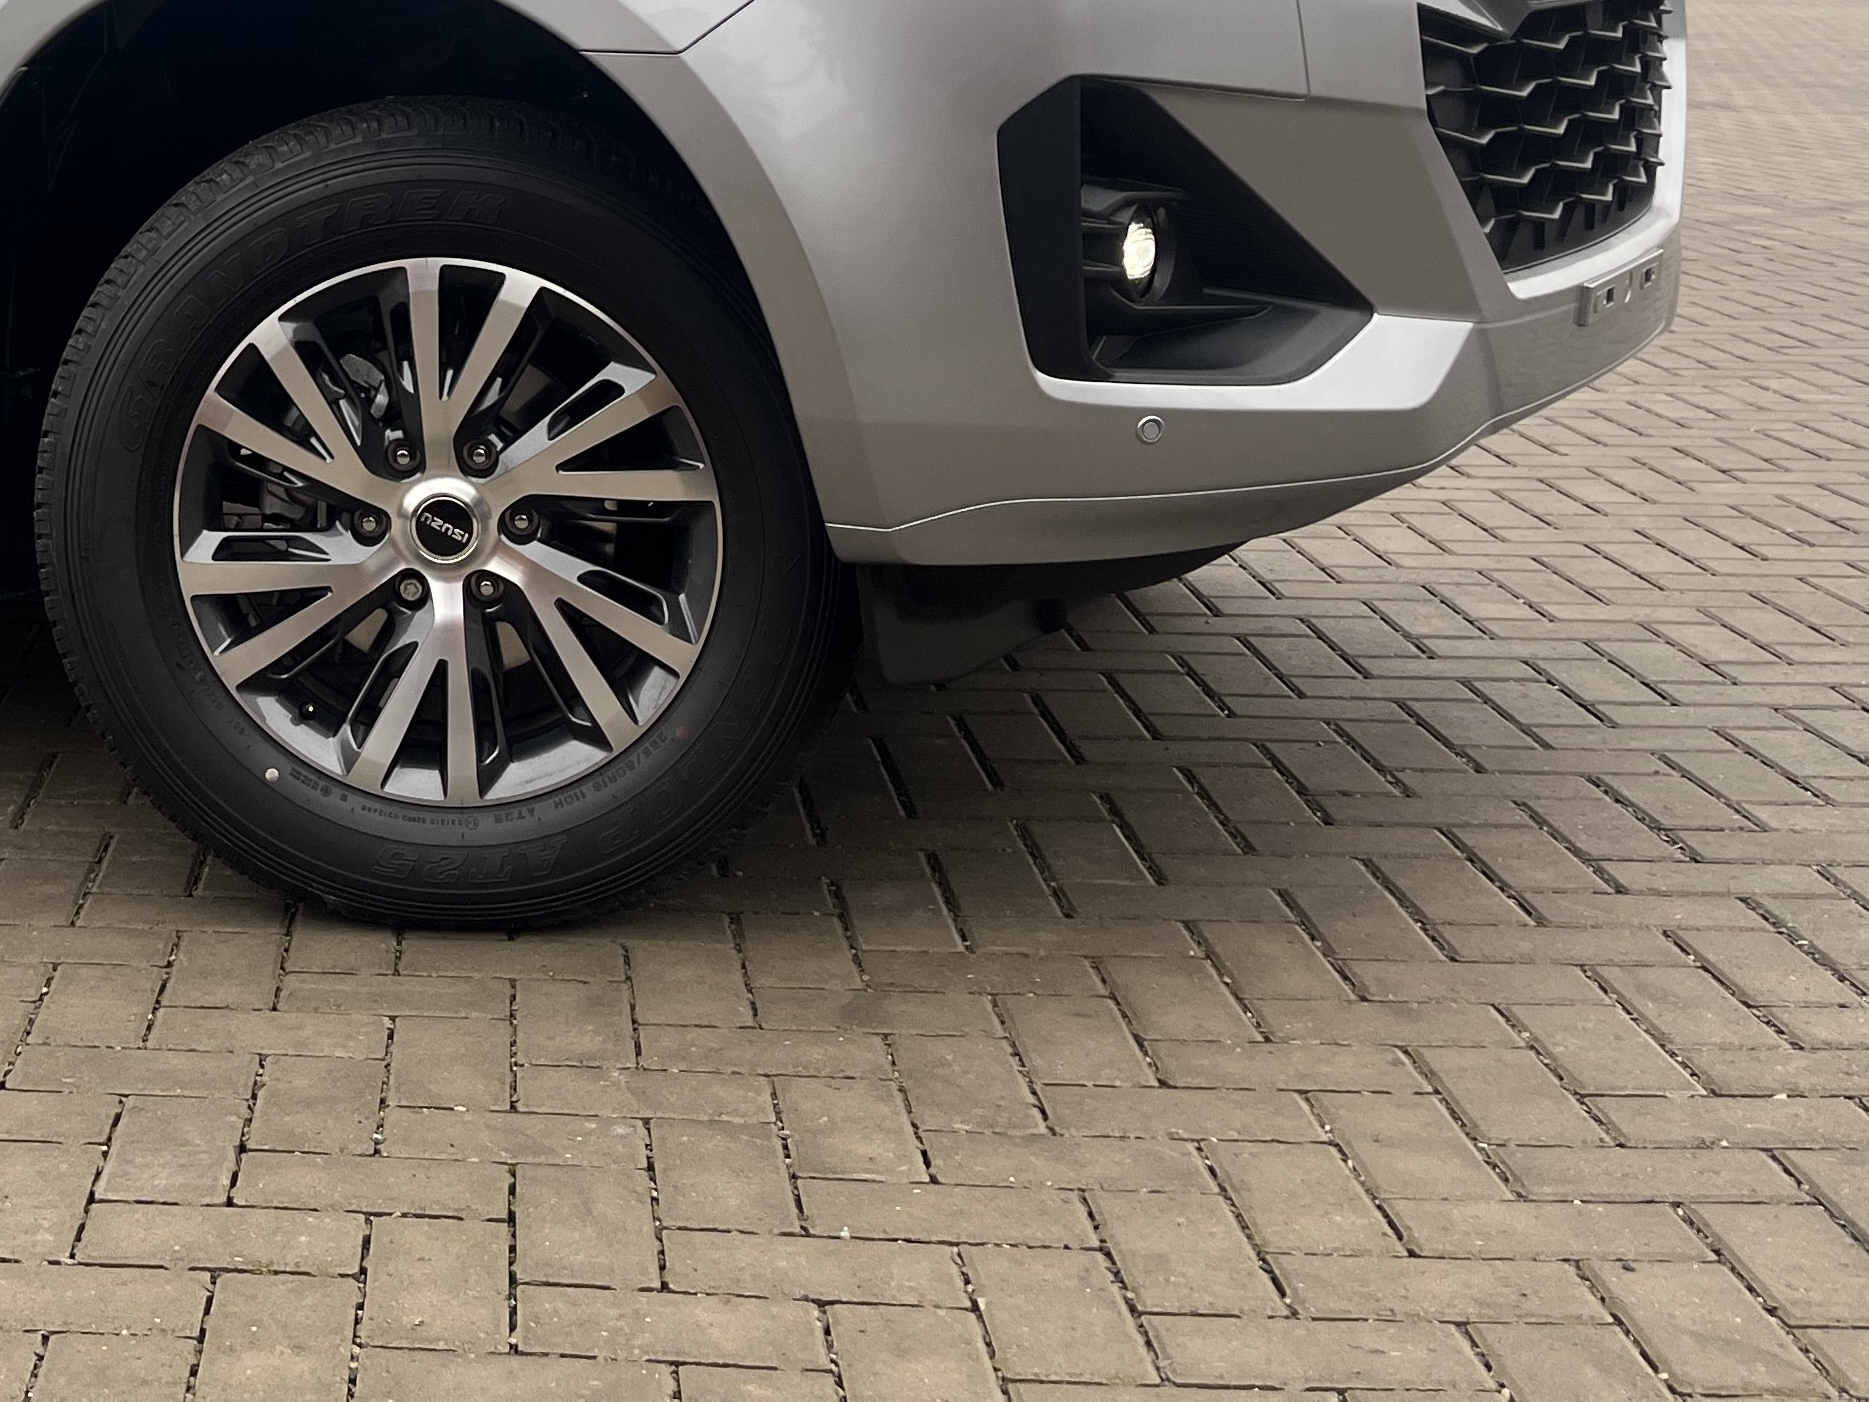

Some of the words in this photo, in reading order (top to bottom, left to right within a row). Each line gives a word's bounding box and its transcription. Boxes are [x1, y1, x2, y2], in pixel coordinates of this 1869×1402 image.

[118, 188, 506, 452] GRANDTREK
[419, 511, 470, 544] ISUZU
[372, 835, 567, 882] AT25
